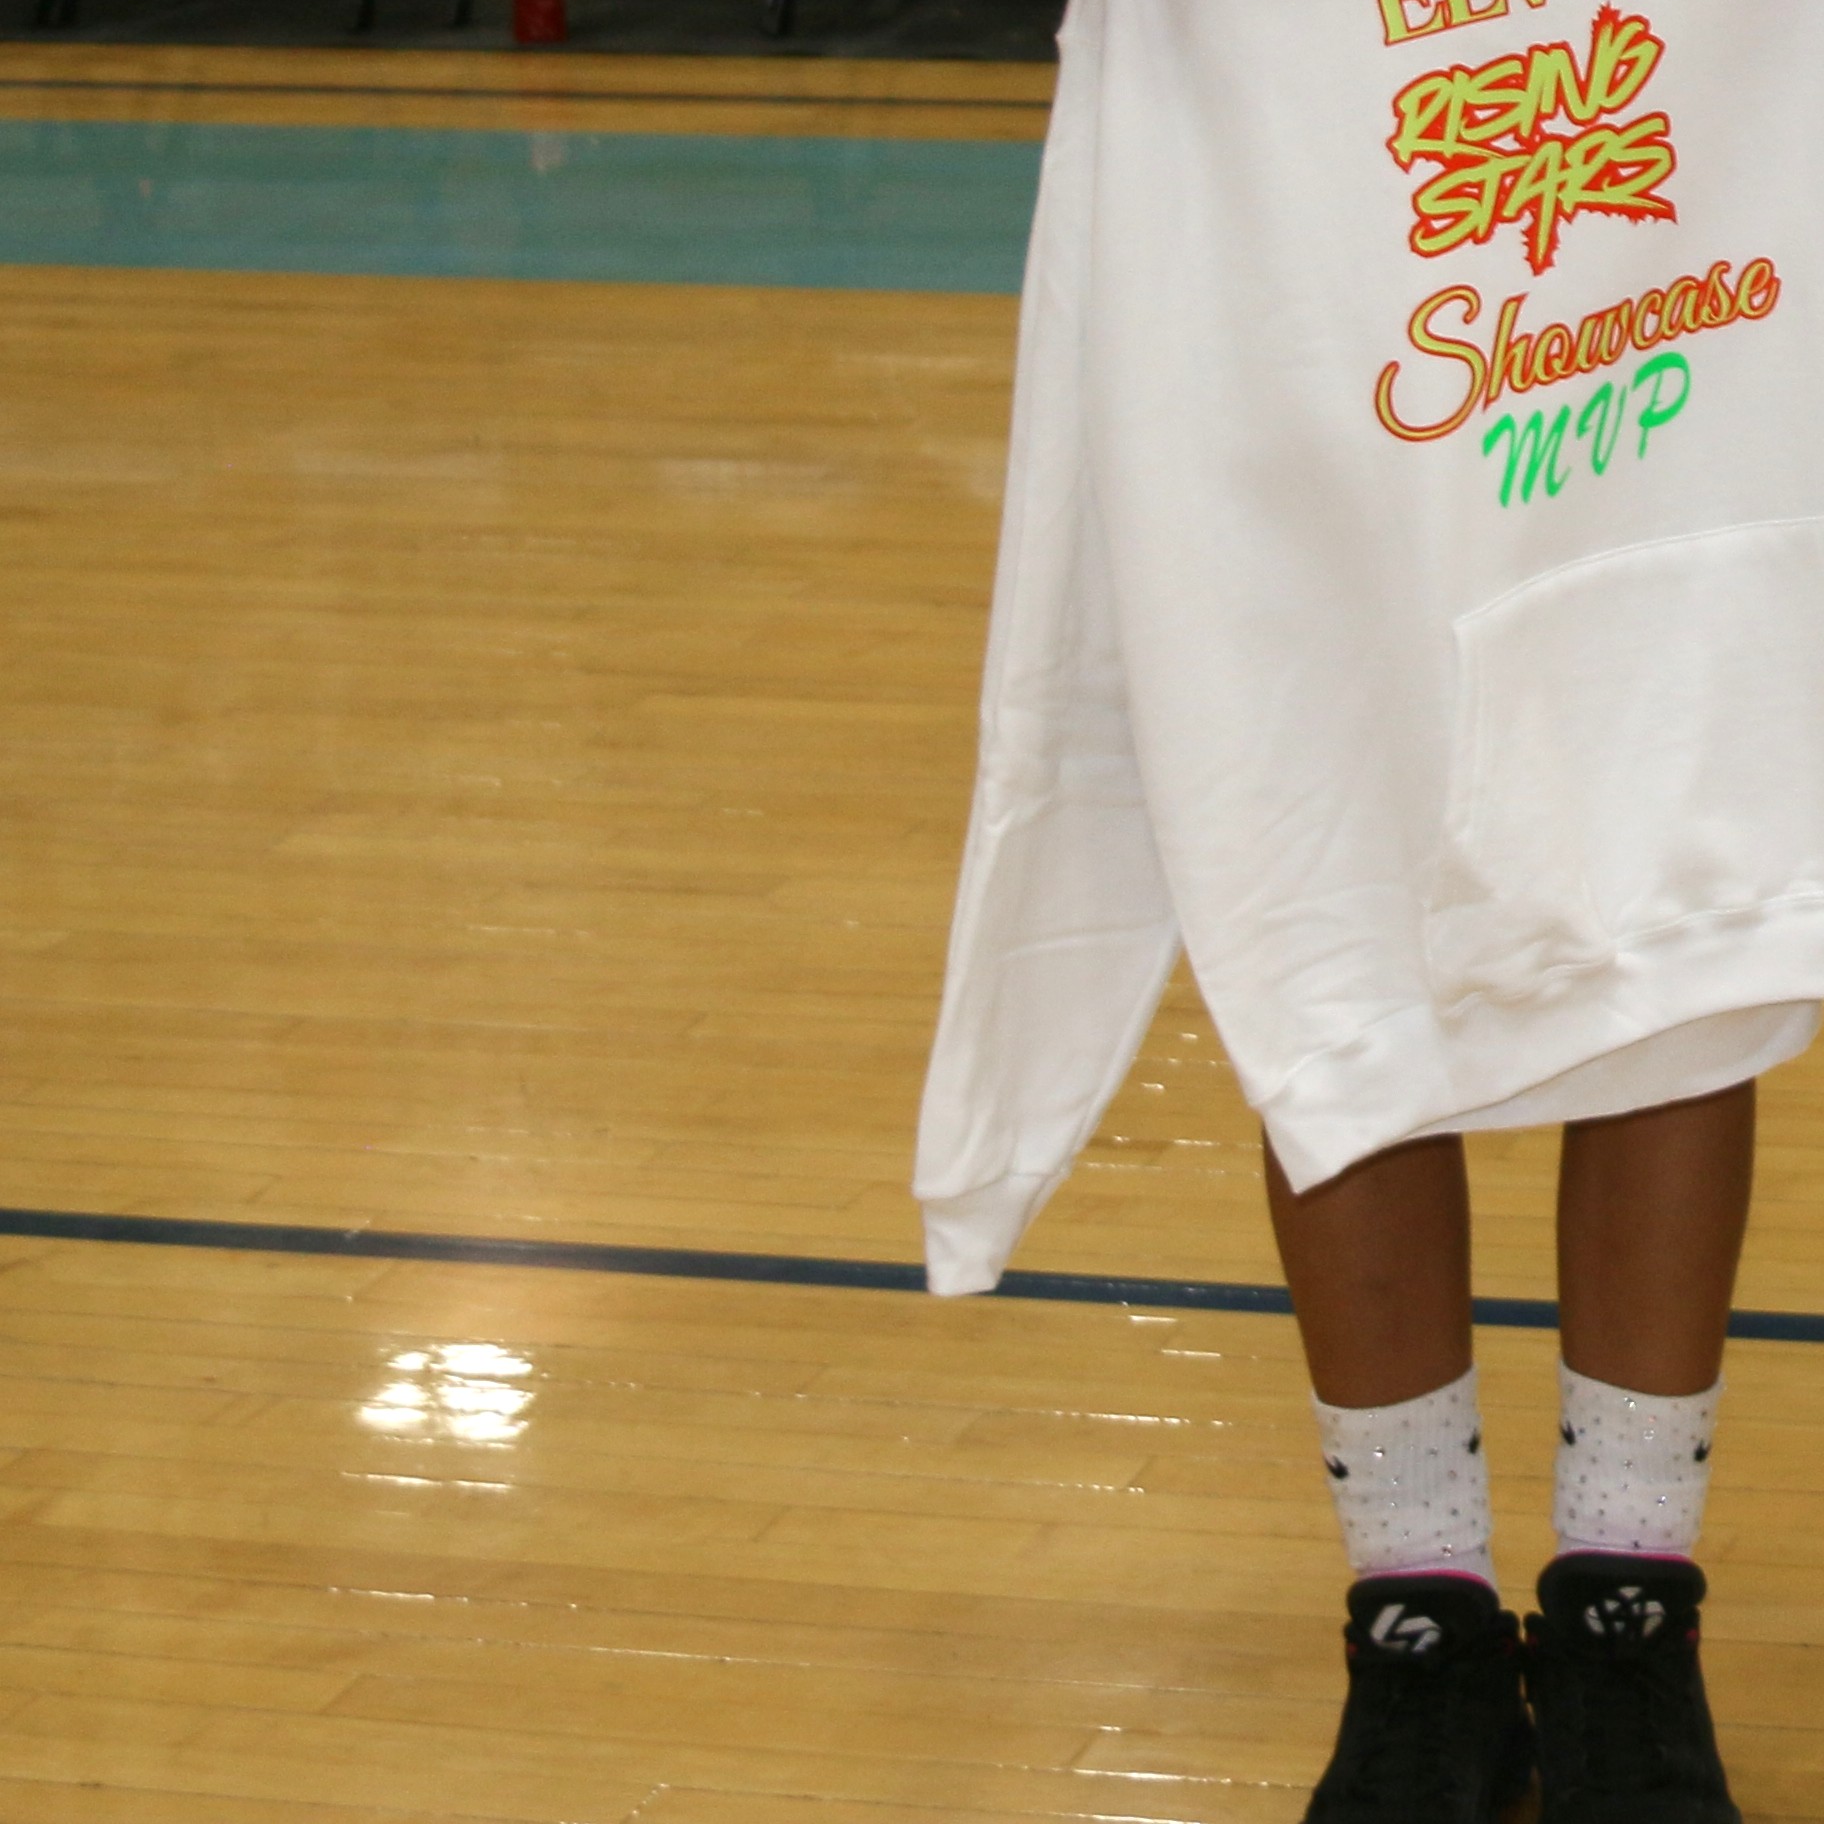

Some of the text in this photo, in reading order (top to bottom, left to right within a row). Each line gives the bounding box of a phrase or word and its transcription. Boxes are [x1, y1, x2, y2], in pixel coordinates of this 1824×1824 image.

[1386, 1, 1665, 174] RISING
[1409, 112, 1679, 277] STARS
[1373, 257, 1782, 443] Showcase
[1481, 351, 1692, 509] MVP
